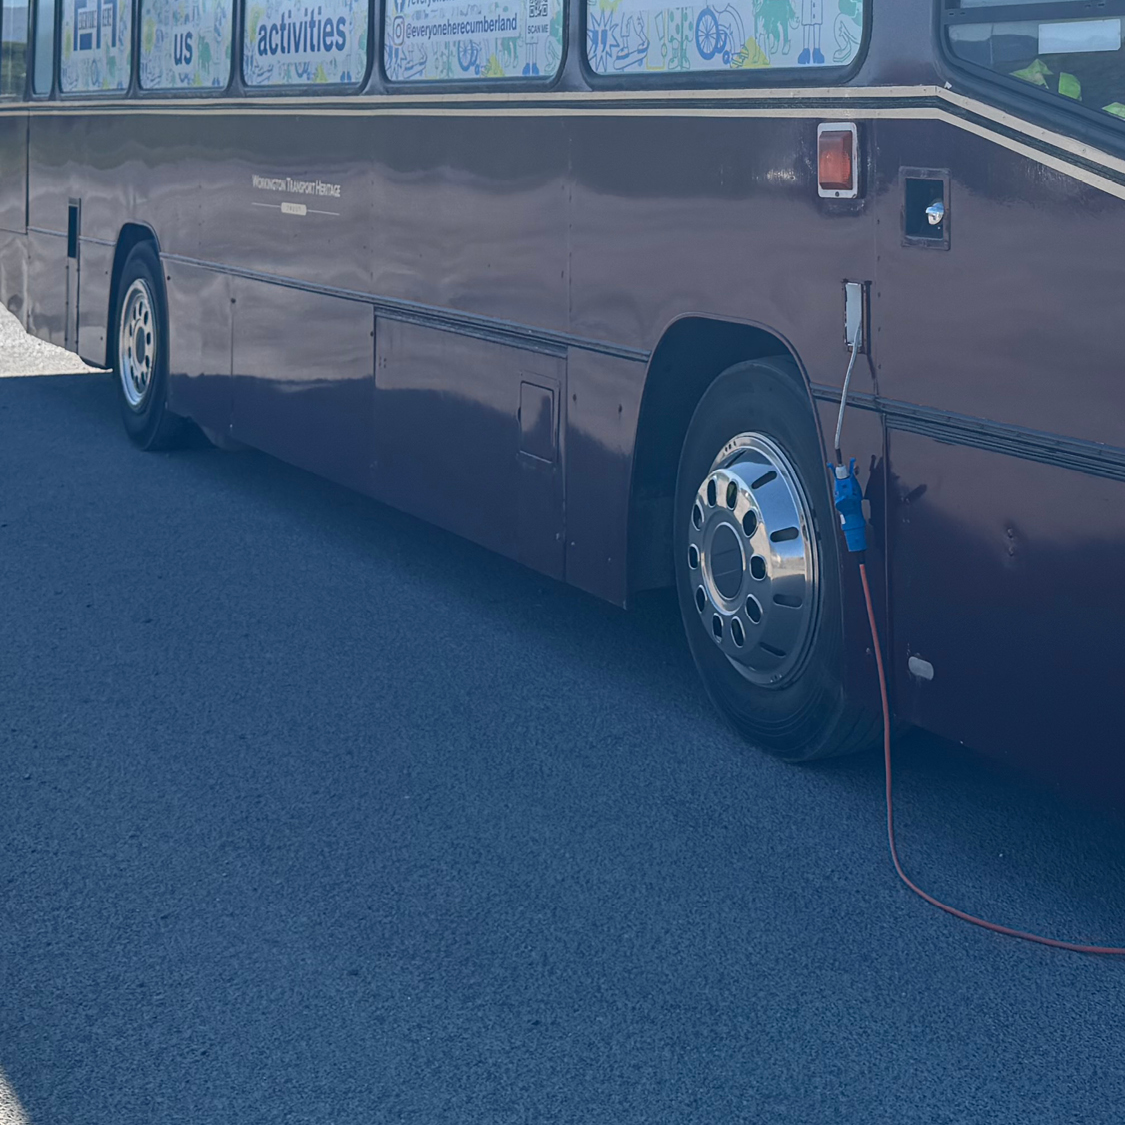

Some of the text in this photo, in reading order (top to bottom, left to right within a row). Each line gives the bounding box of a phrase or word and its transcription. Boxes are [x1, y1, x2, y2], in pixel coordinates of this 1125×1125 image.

[258, 7, 347, 56] activities
[405, 13, 518, 39] @everyoneherecumberland
[527, 24, 549, 34] SCAN ME
[173, 31, 193, 66] us
